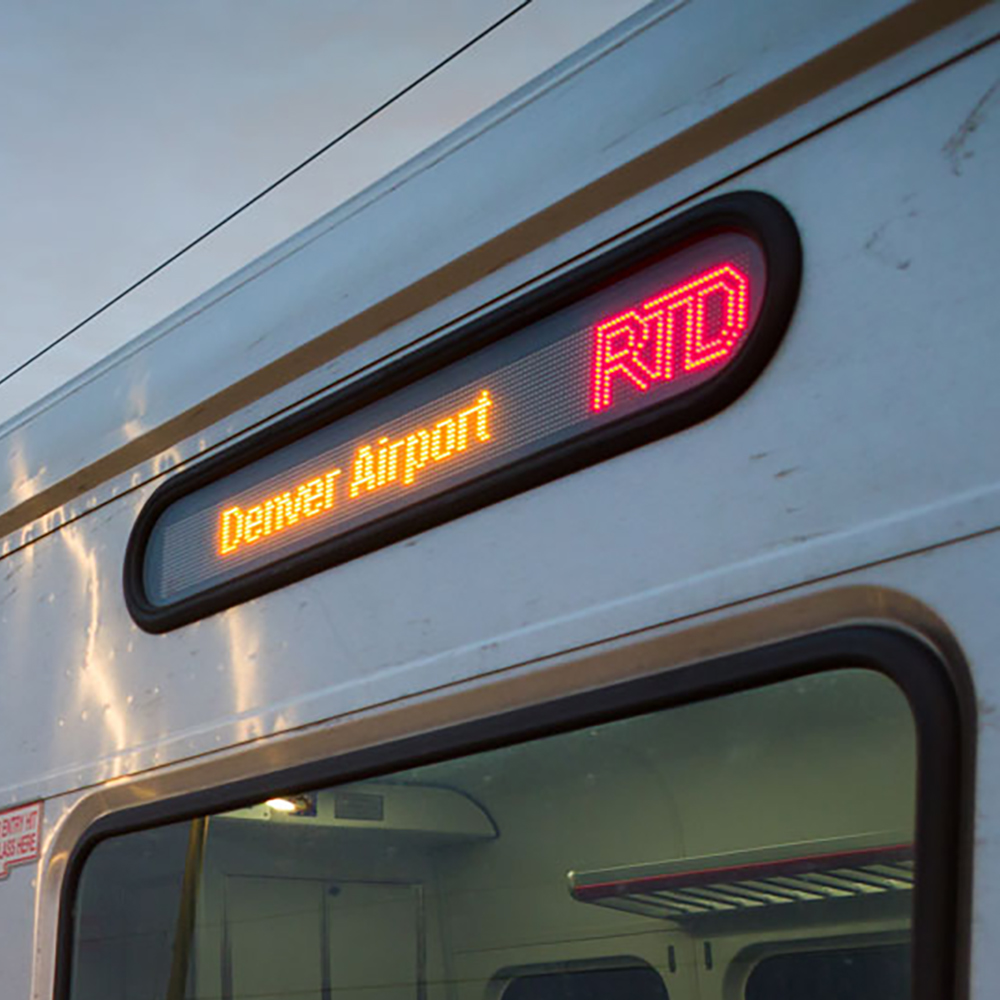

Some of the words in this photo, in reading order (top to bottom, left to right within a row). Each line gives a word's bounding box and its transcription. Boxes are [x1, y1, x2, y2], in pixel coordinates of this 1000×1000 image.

[592, 265, 748, 412] RTD
[217, 469, 342, 556] Denver
[349, 390, 493, 498] Airport
